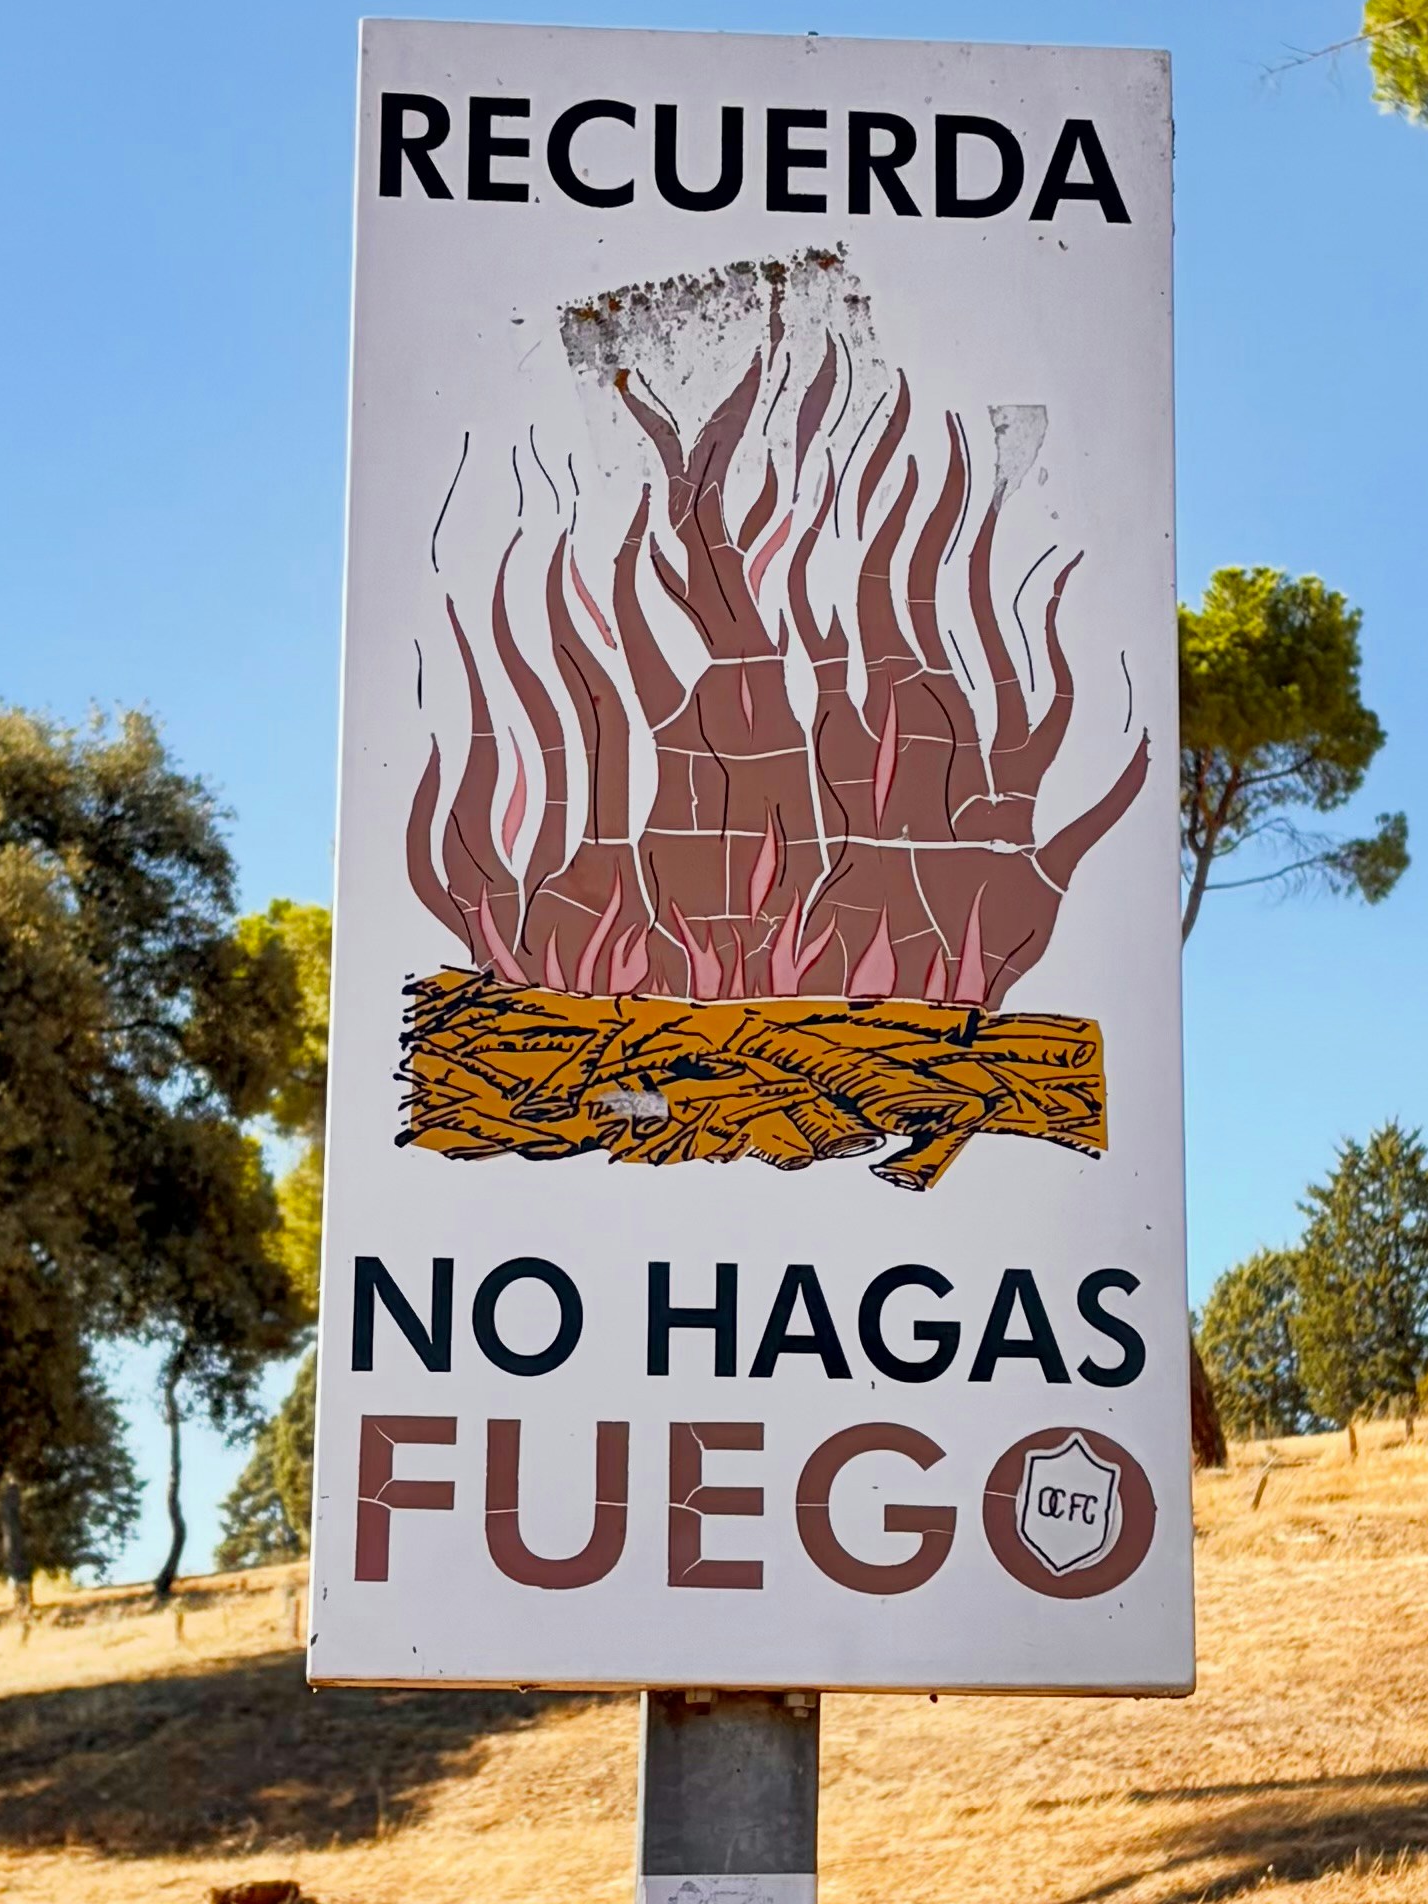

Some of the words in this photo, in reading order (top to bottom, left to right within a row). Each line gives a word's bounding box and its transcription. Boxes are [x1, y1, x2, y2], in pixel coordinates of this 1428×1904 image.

[378, 92, 1132, 225] RECUERDA
[351, 1255, 584, 1377] NO
[646, 1261, 1146, 1388] HAGAS
[354, 1414, 1157, 1600] FUEGO
